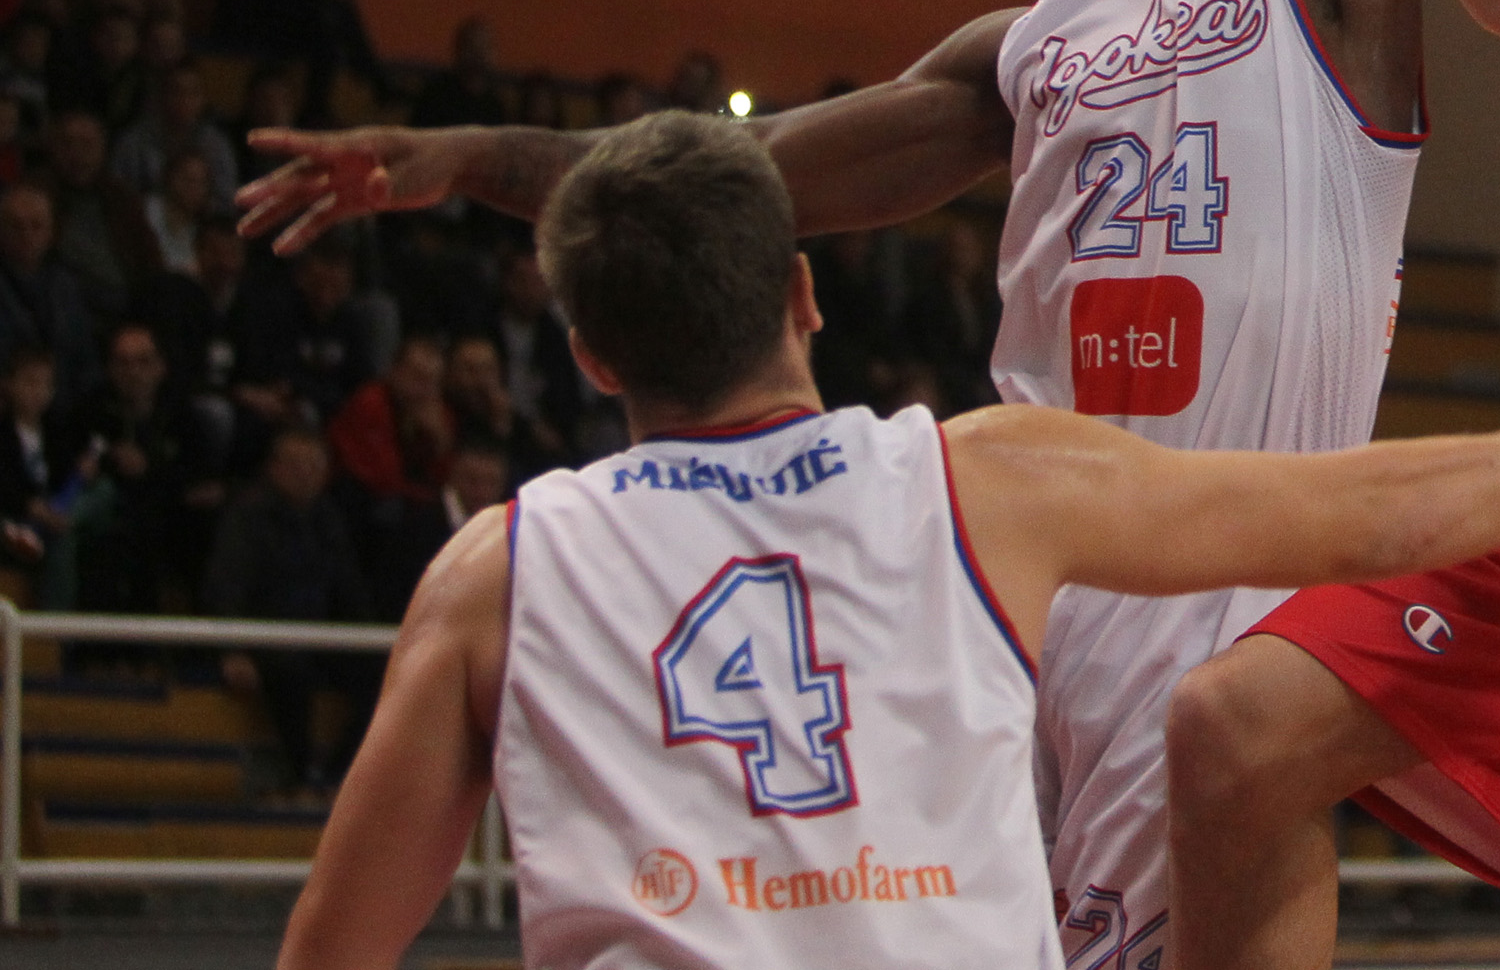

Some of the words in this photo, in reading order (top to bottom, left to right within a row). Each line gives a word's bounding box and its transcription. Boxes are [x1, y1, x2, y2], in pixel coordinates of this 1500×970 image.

[1067, 120, 1229, 264] 24
[1079, 317, 1179, 370] m:tel
[651, 552, 860, 818] 4
[716, 844, 957, 911] Hemofarm
